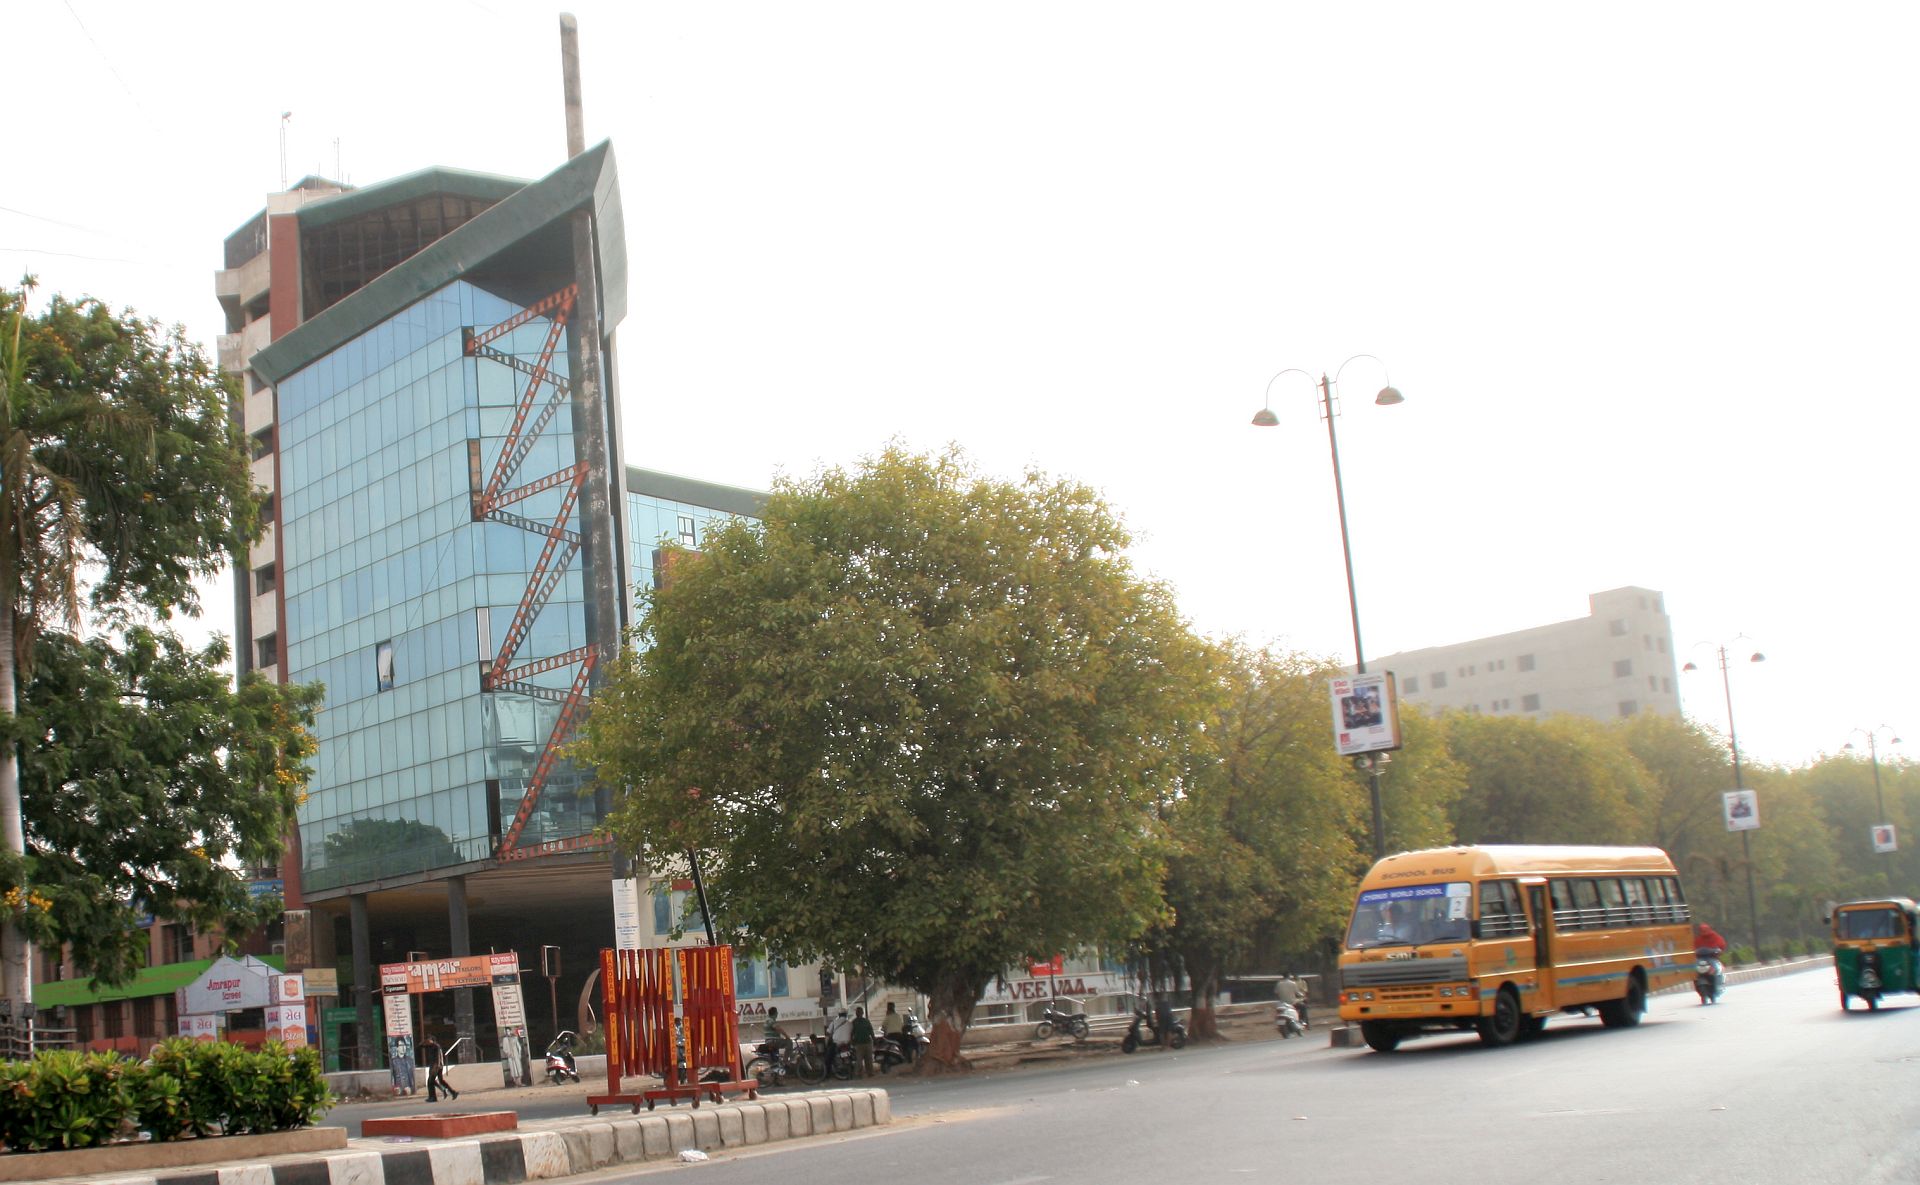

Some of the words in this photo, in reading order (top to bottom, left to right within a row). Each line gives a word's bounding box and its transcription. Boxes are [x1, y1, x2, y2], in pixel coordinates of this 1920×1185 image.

[1431, 867, 1456, 876] BUS
[1415, 887, 1443, 896] SCHOOL
[1454, 900, 1461, 912] 2
[207, 979, 240, 991] Amrapur
[408, 961, 460, 990] amar
[680, 953, 688, 998] STOP
[1008, 981, 1047, 1000] VEE
[1053, 978, 1086, 997] VAA
[610, 1013, 619, 1063] CITY
[684, 1017, 692, 1067] POLICE
